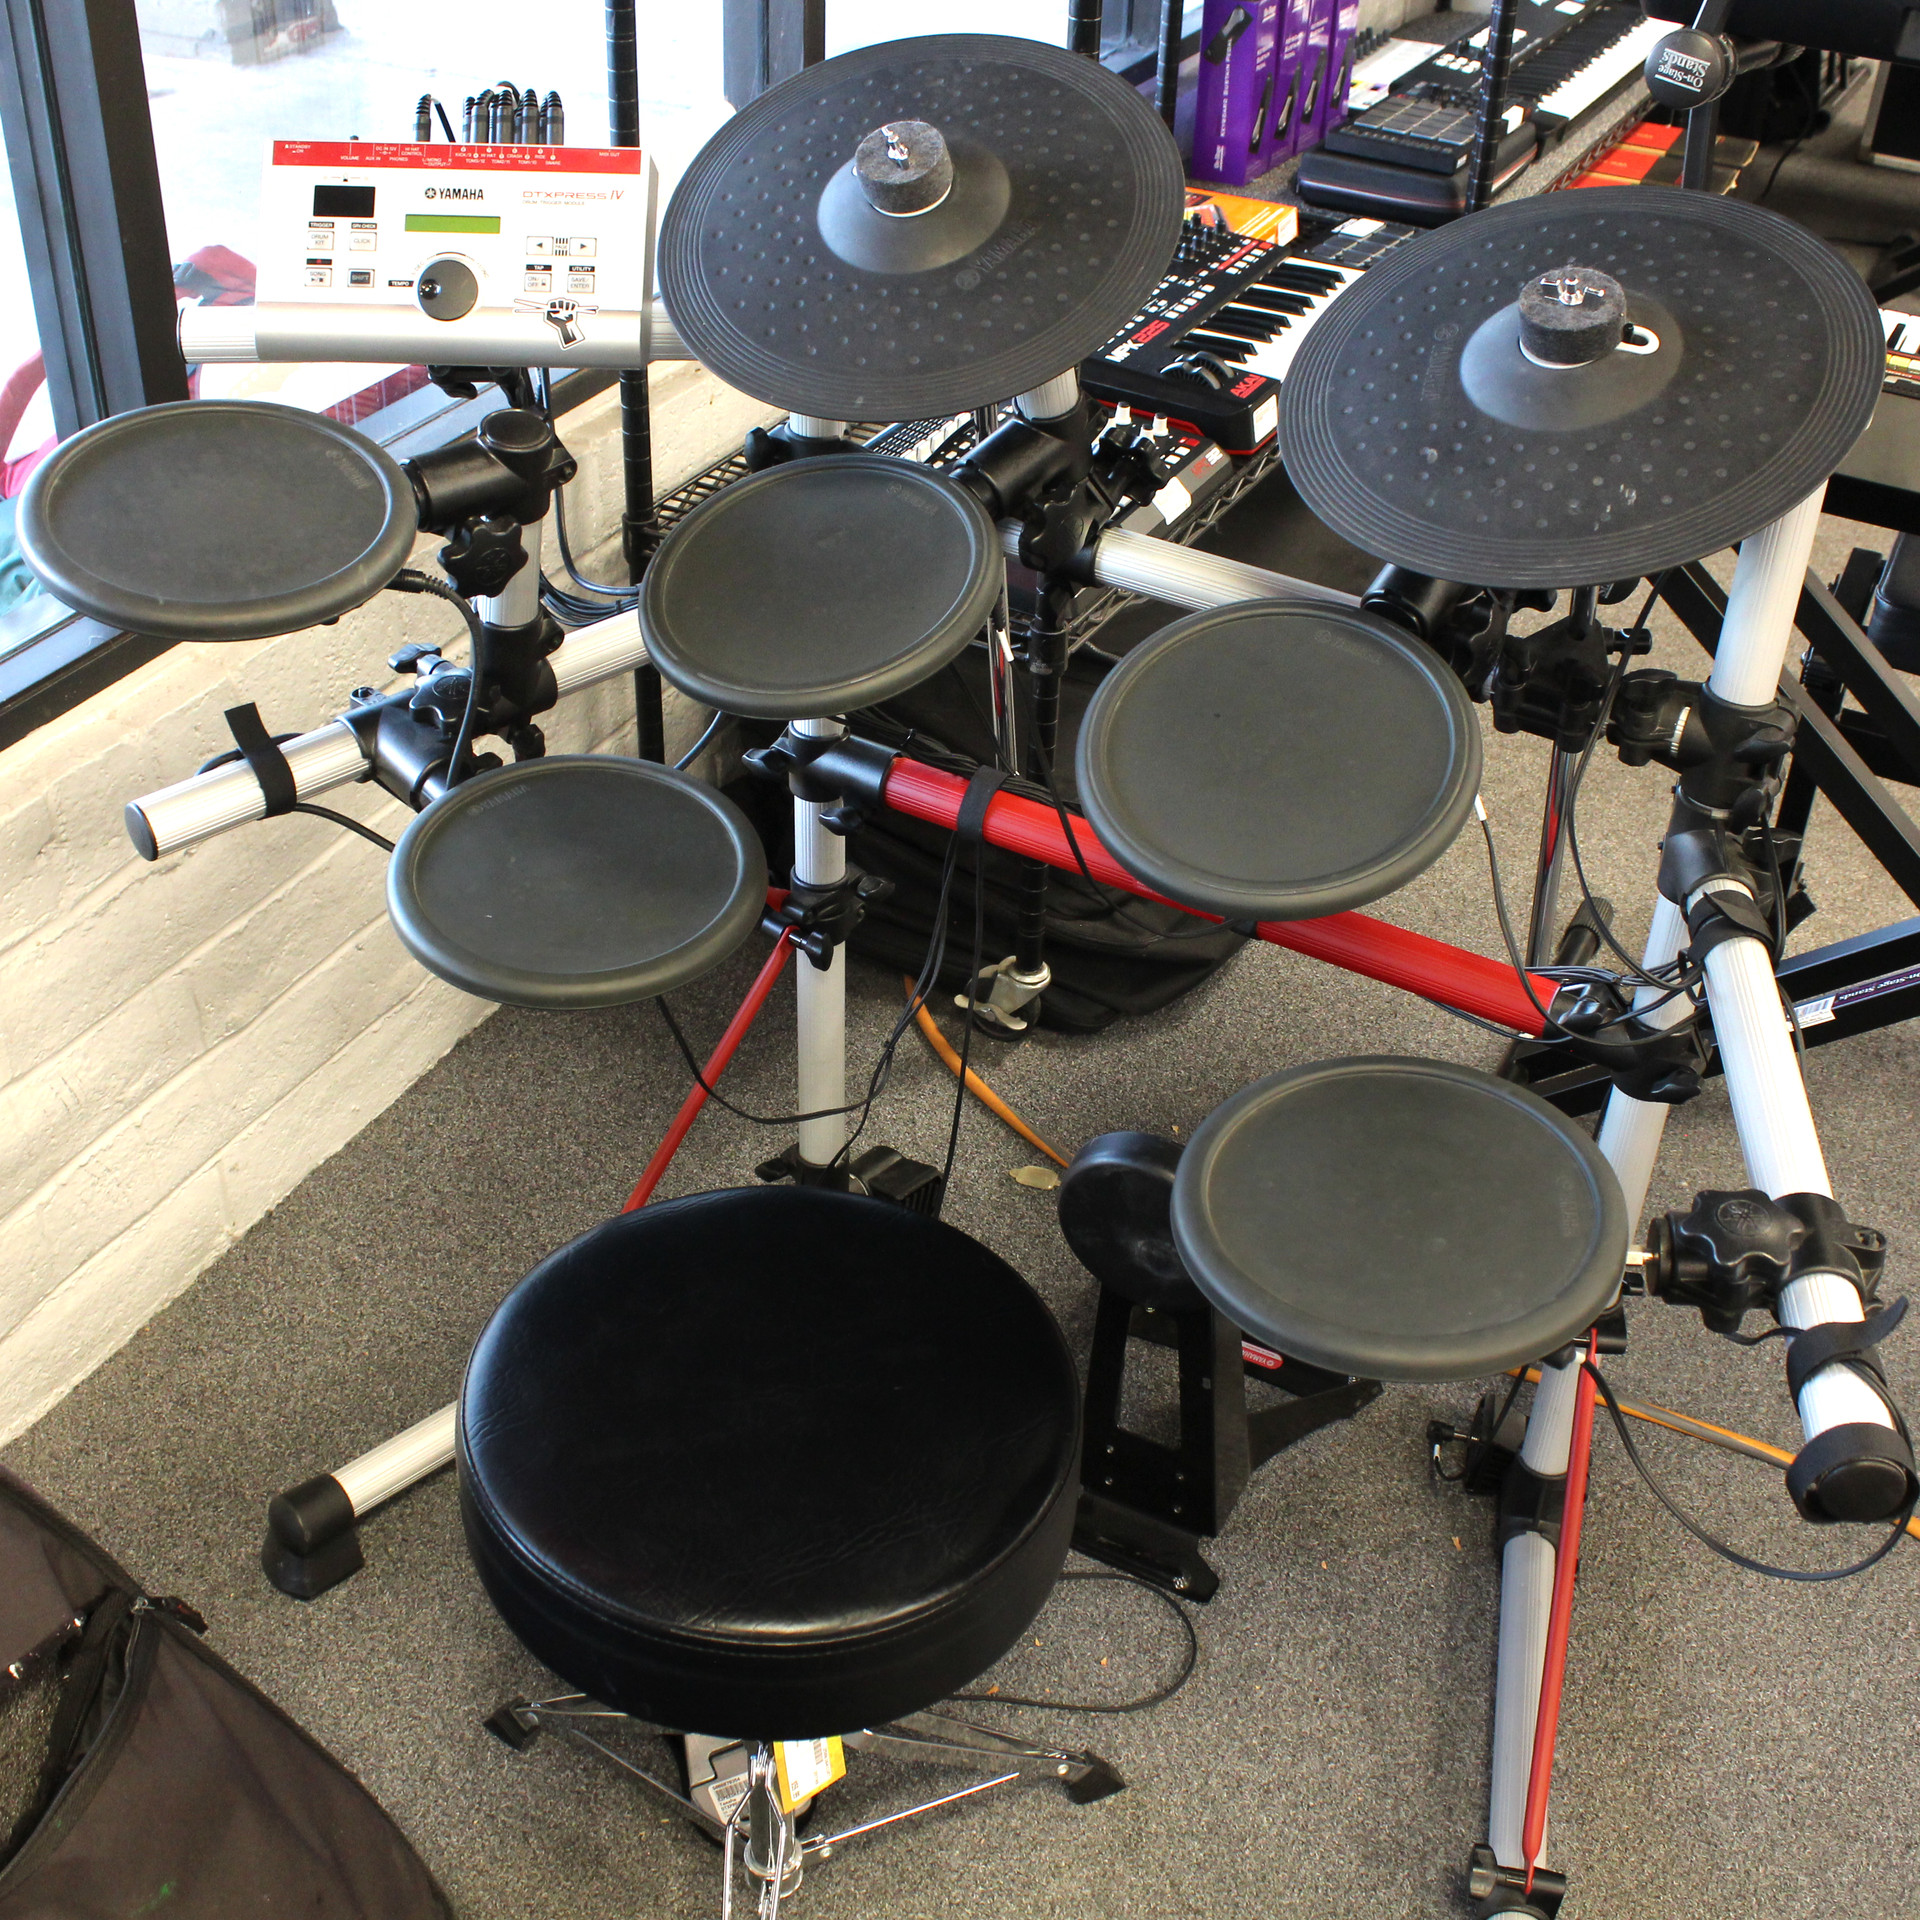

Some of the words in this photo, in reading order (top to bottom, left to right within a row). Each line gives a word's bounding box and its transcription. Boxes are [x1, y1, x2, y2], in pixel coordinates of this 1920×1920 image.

[1657, 63, 1704, 88] On-Stage
[439, 188, 484, 200] YAMAHA
[522, 190, 607, 200] DTXPRESS
[1229, 373, 1264, 396] AKAI
